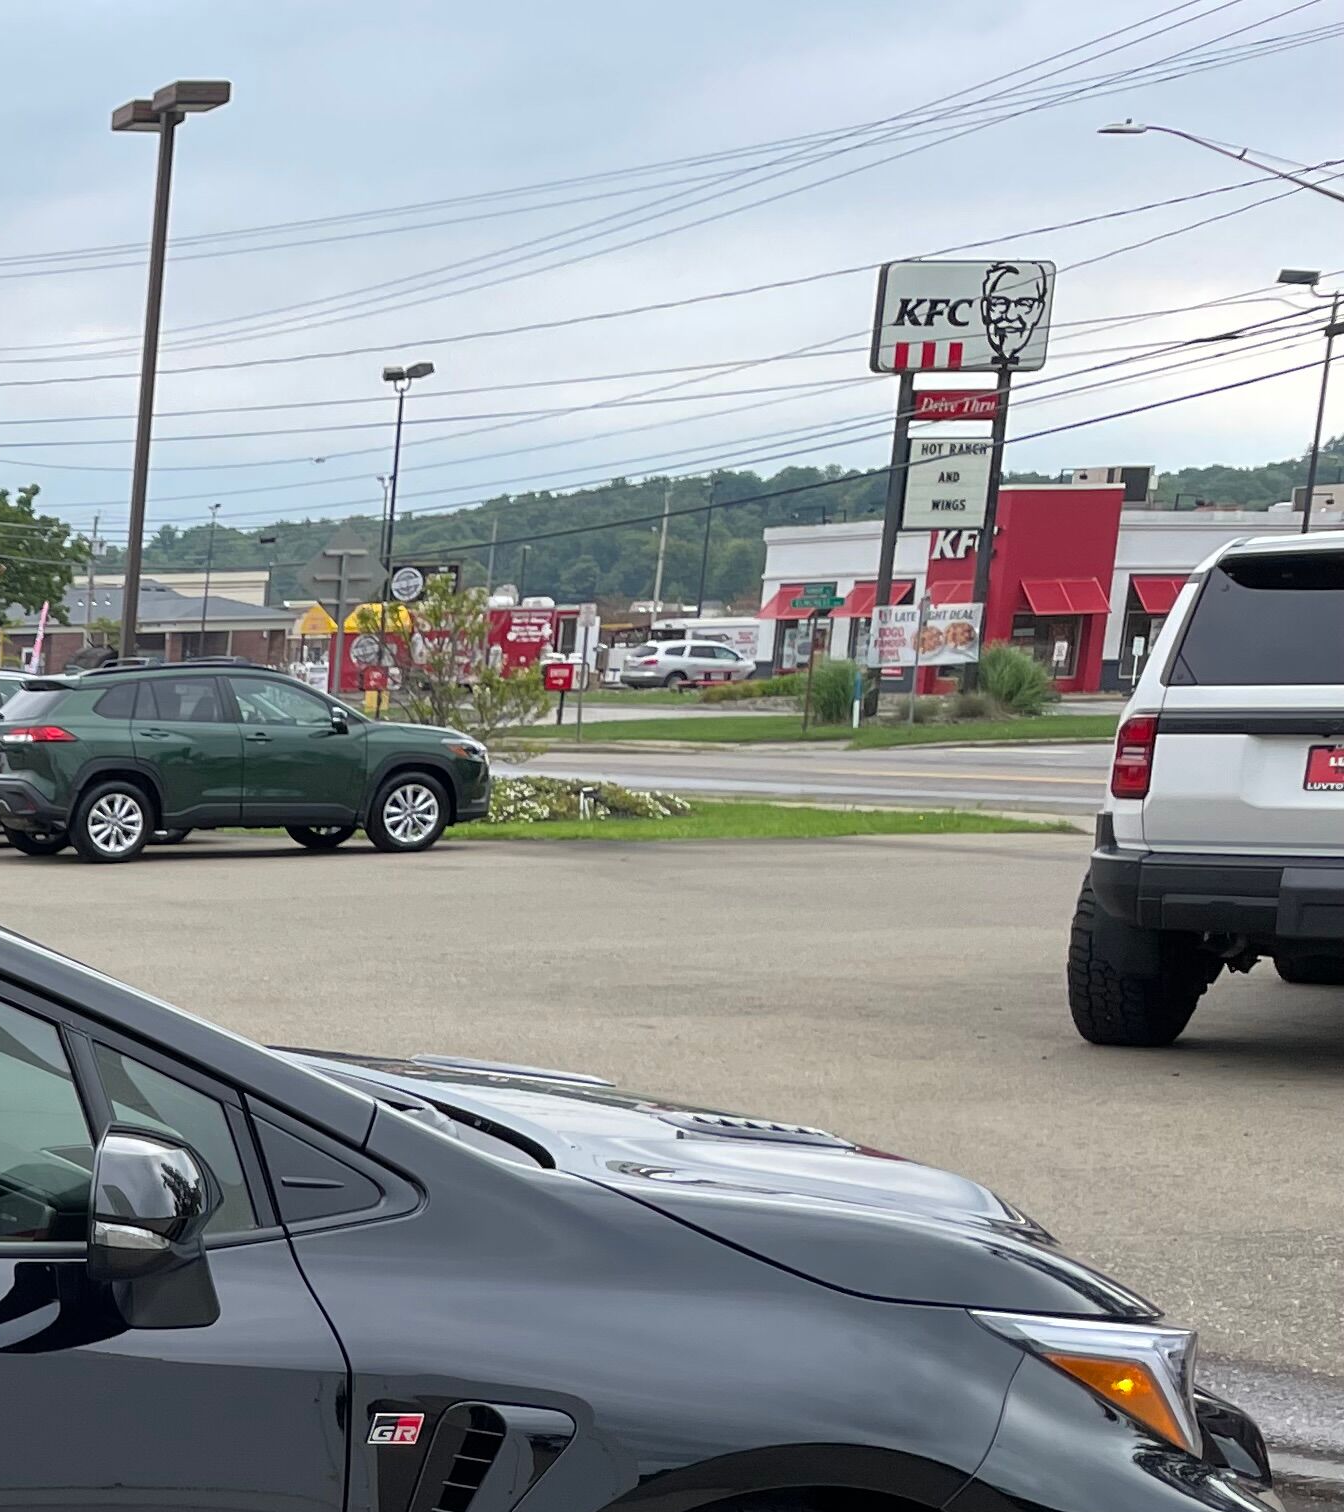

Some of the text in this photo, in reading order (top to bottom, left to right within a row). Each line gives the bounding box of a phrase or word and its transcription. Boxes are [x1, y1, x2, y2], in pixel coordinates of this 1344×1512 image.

[892, 298, 974, 327] KFC
[921, 396, 996, 413] Drive Thru
[921, 443, 988, 456] HOT RANCH
[938, 471, 960, 483] AND
[931, 499, 967, 511] WINGS
[895, 611, 917, 622] LATE
[949, 610, 974, 620] DEAL
[372, 1425, 417, 1442] GR
